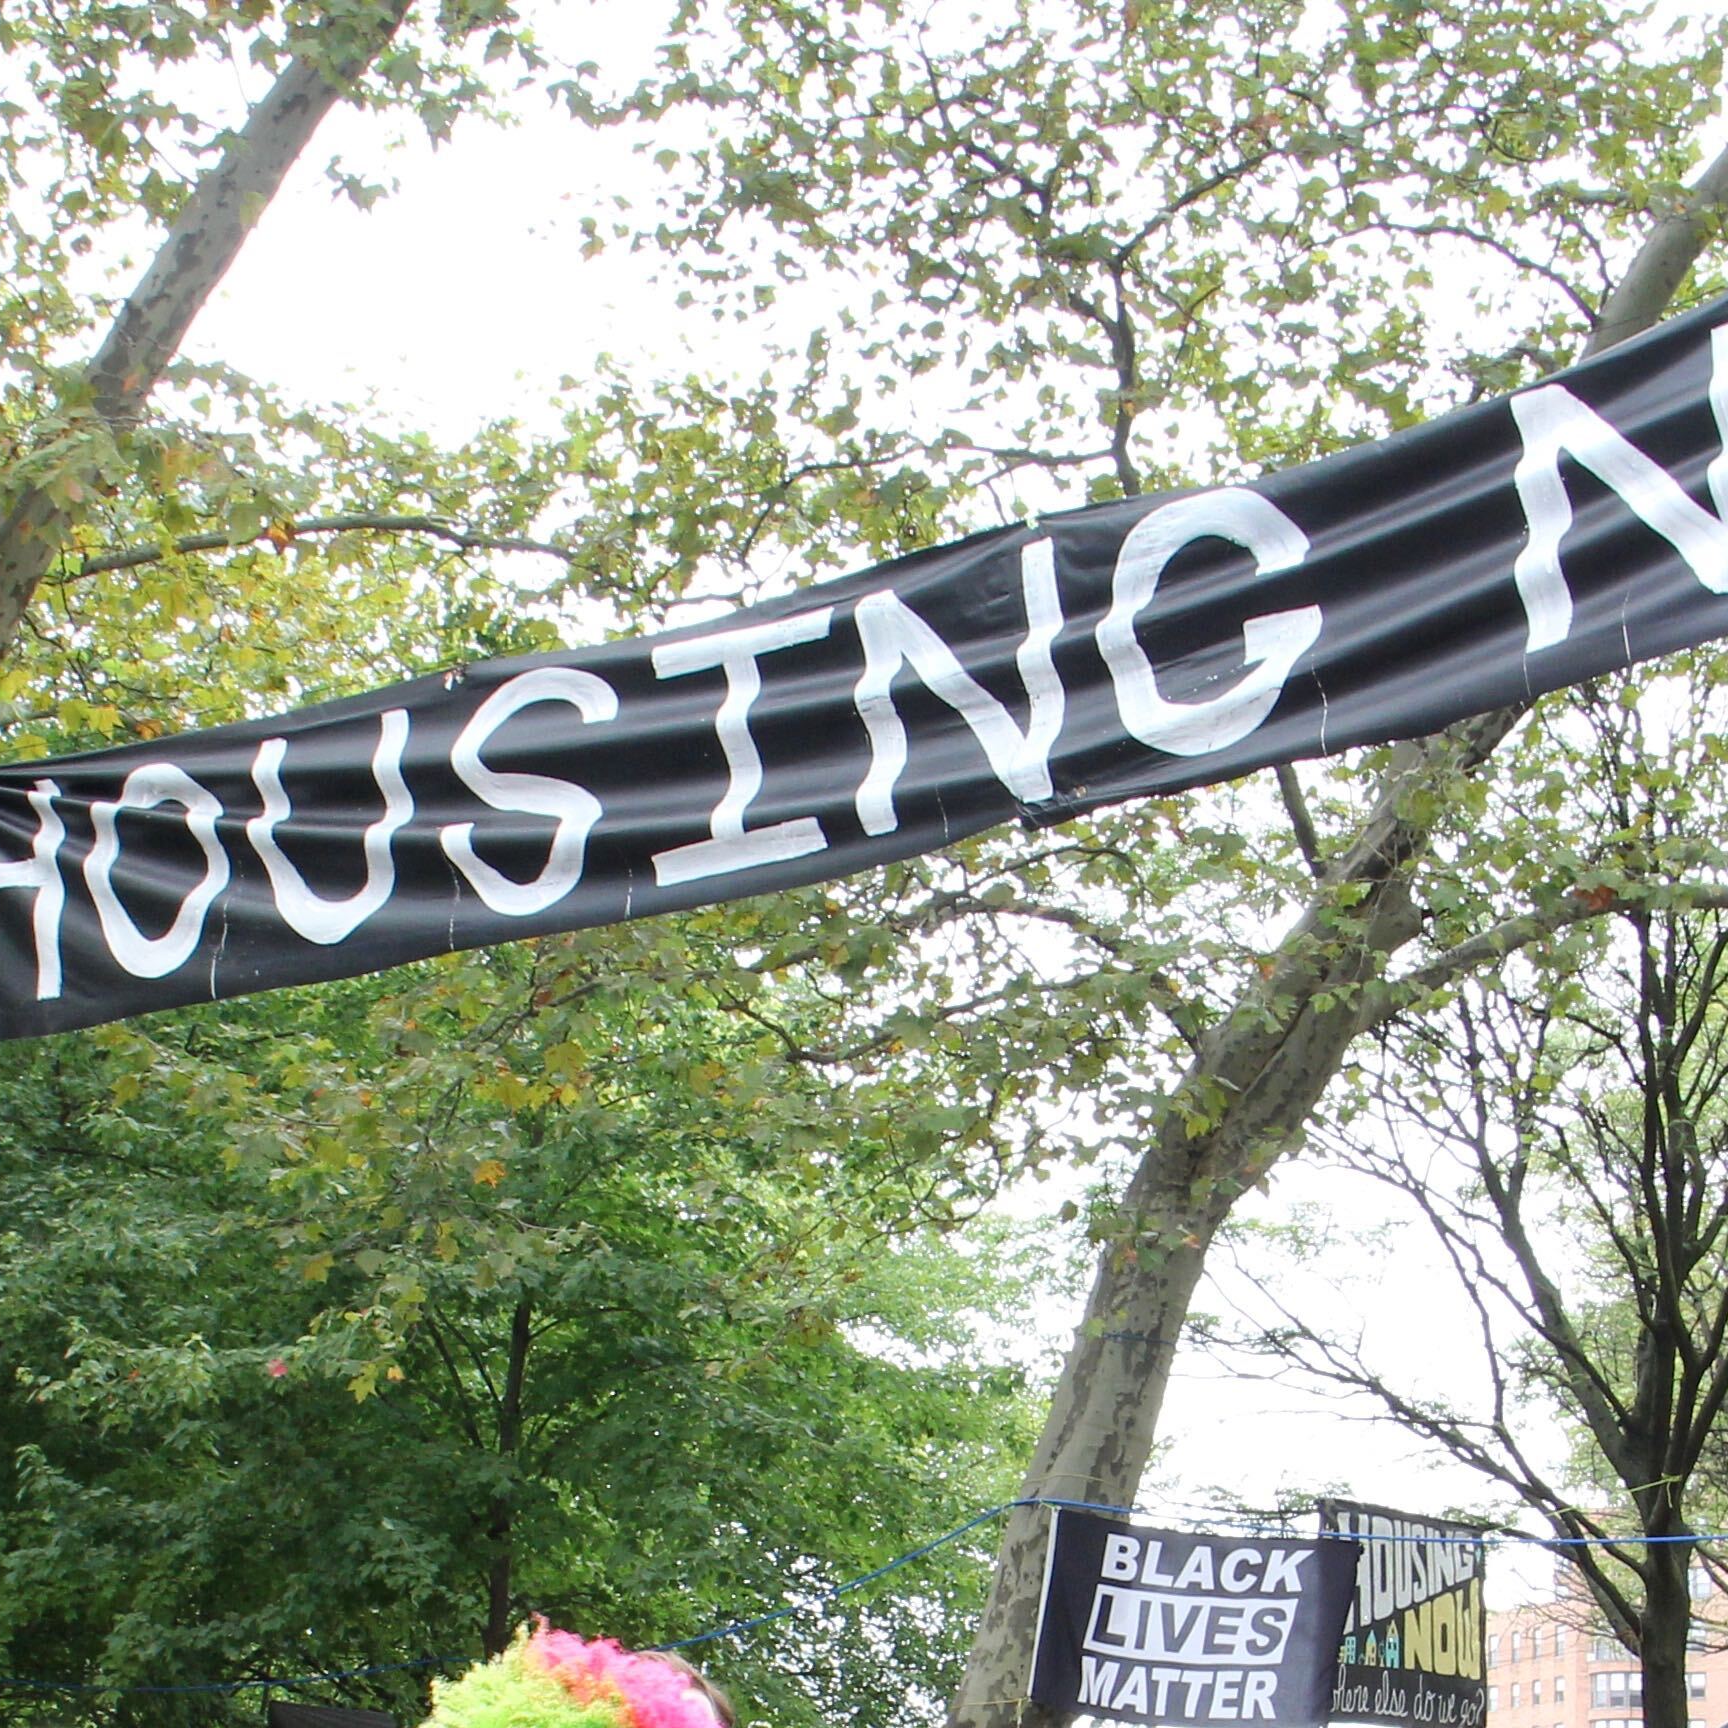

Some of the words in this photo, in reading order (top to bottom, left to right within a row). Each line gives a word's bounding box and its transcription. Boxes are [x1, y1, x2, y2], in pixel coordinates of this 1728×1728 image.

[1101, 1533, 1315, 1593] BLACK
[1337, 1512, 1474, 1635] HOUSING
[1088, 1591, 1288, 1657] LIVES
[1404, 1577, 1481, 1680] NOW
[1077, 1656, 1278, 1720] MATTER
[1374, 1670, 1408, 1718] else
[1413, 1674, 1436, 1722] do
[1438, 1692, 1458, 1724] we
